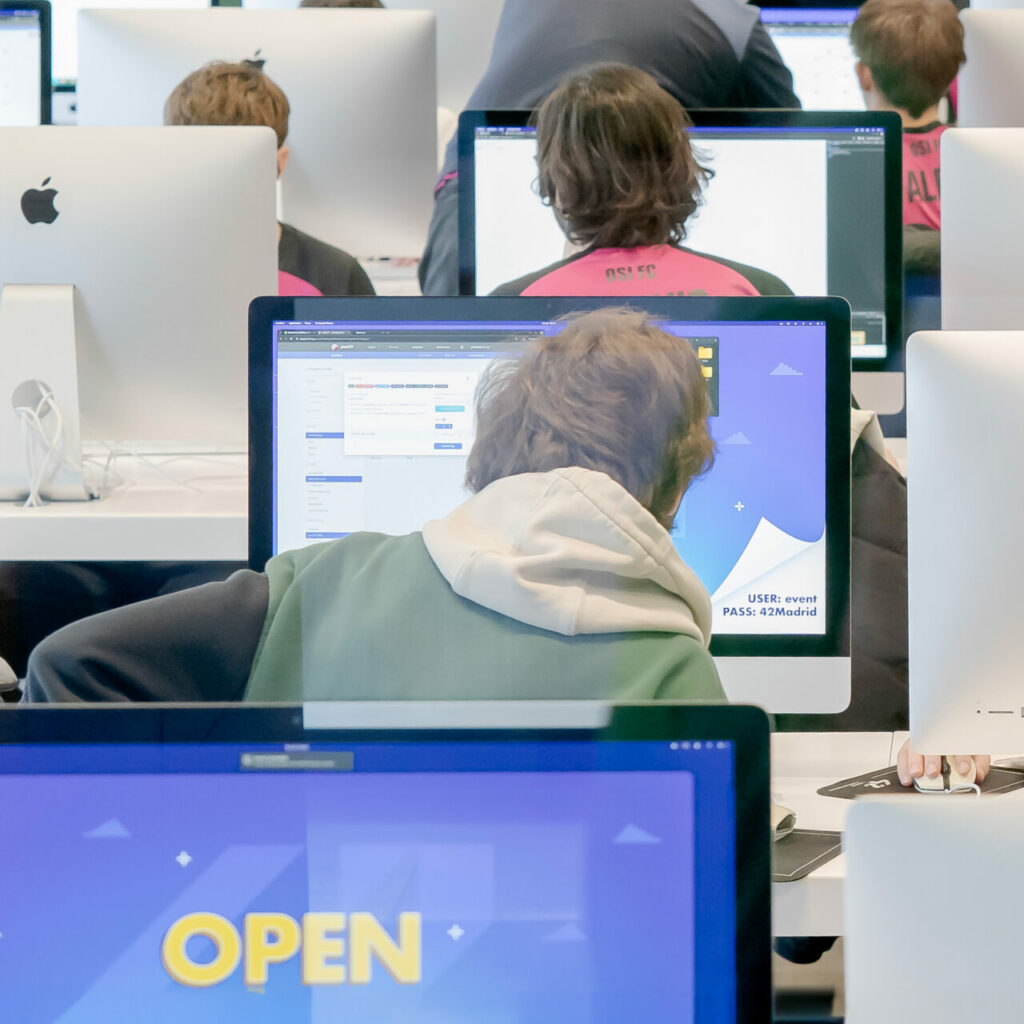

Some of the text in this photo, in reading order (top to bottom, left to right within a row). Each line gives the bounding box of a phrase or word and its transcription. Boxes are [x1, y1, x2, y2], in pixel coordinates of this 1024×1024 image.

[748, 594, 817, 603] USER: event
[723, 607, 817, 616] PASS: 42Madrid
[162, 911, 421, 987] OPEN
